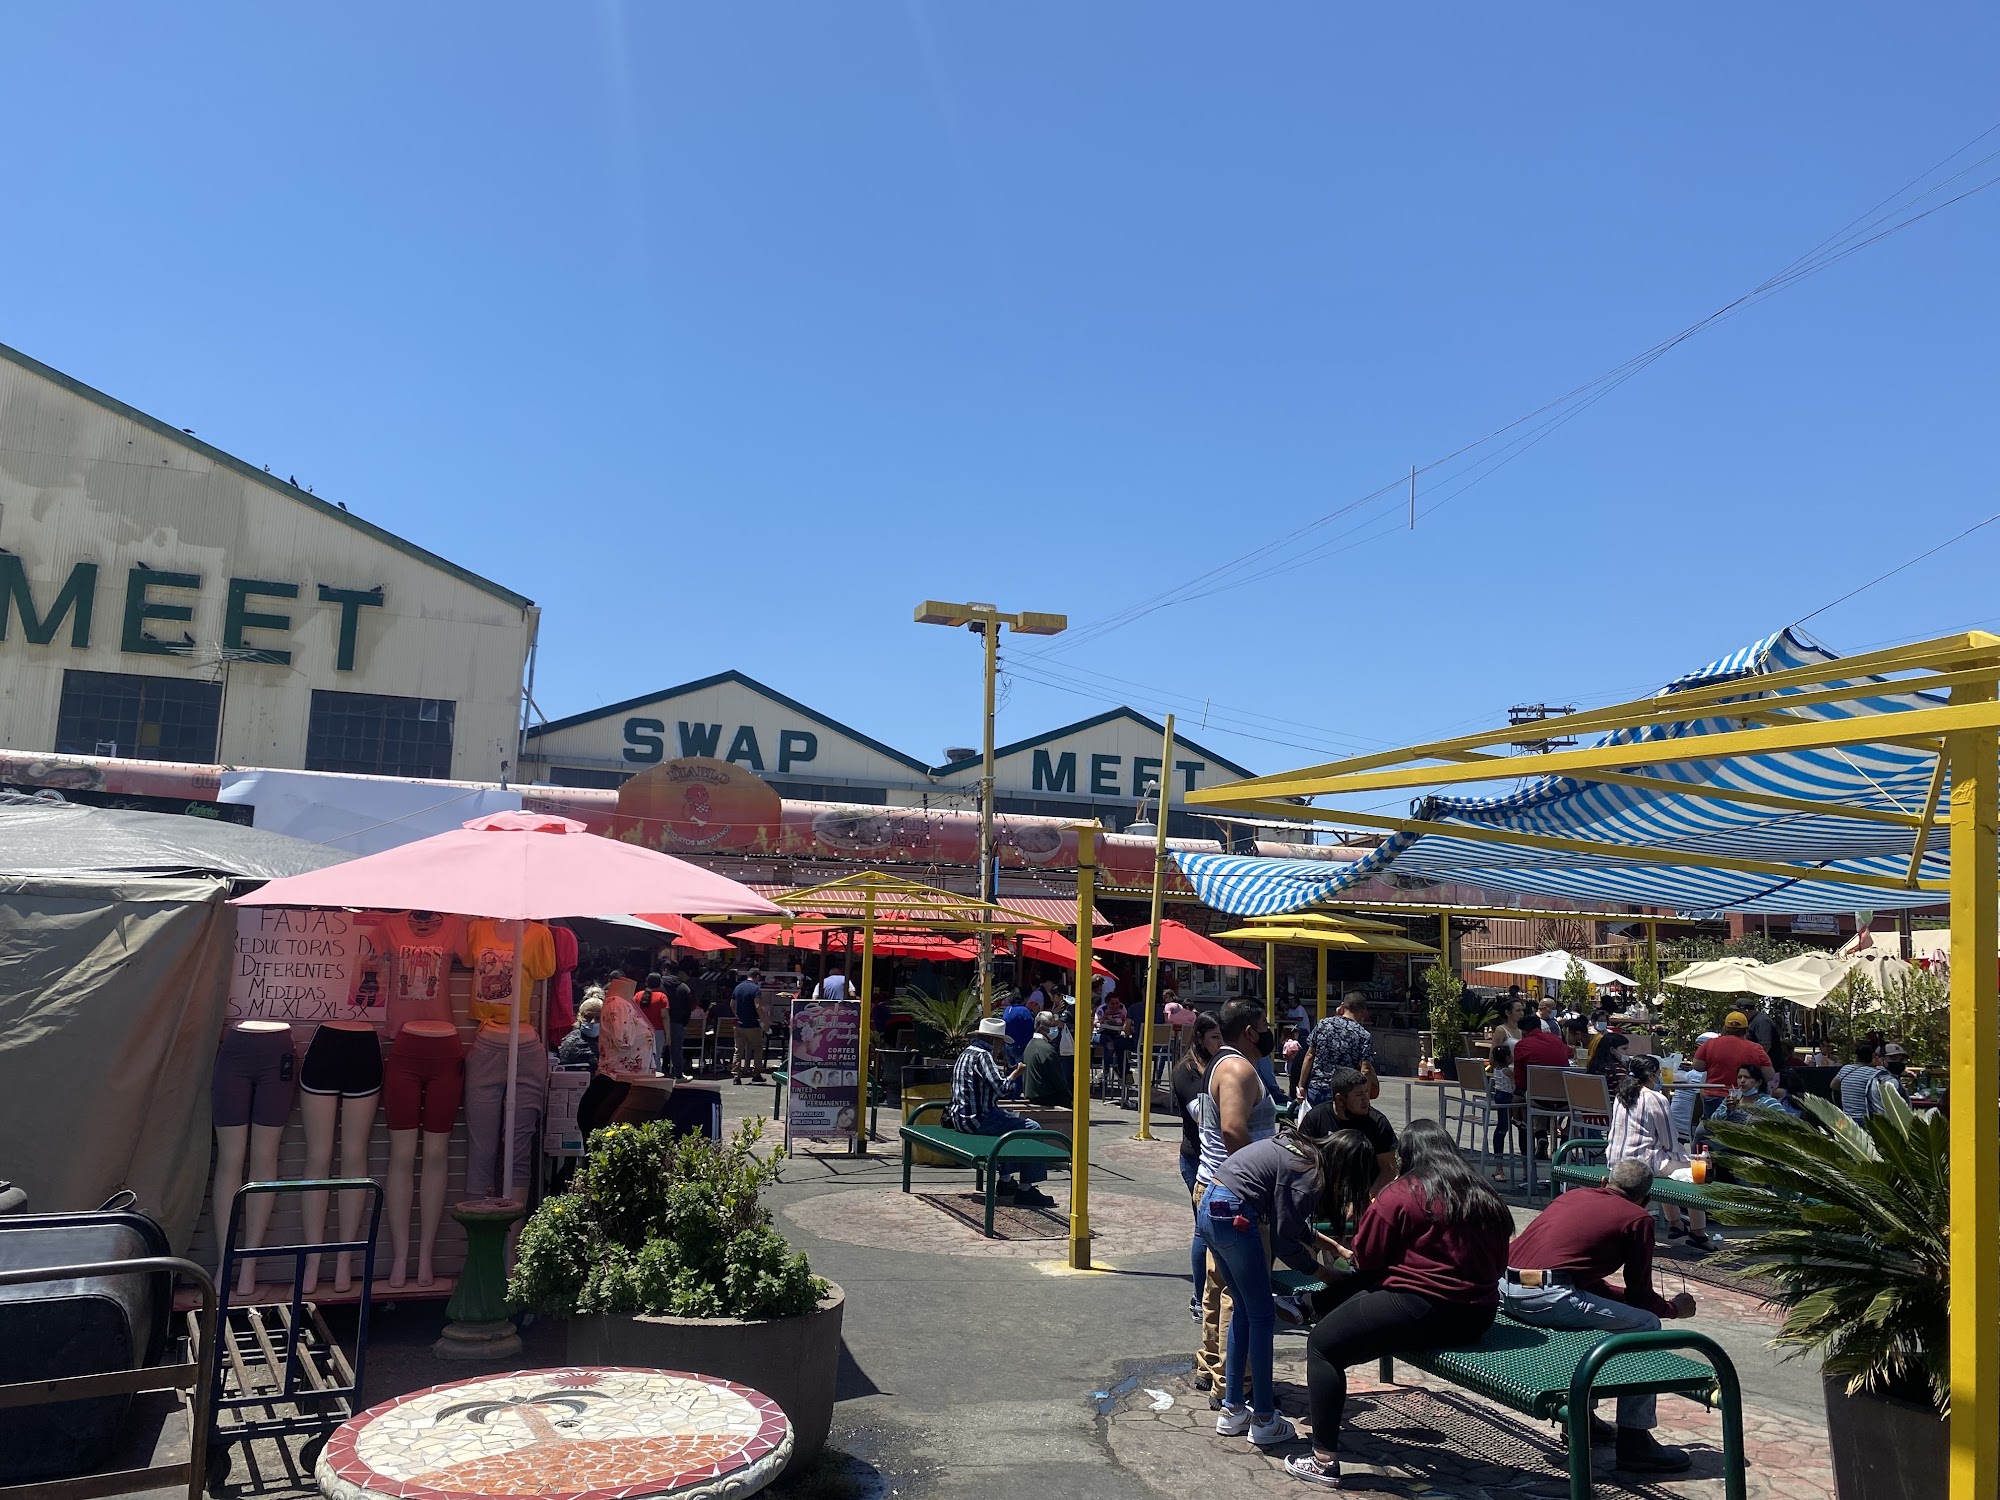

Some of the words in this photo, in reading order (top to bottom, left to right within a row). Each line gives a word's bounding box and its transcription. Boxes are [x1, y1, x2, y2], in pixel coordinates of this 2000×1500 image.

[0, 554, 384, 671] MEET
[622, 718, 818, 773] SWAP
[666, 765, 731, 785] DIABLO
[1032, 749, 1205, 798] MEET
[662, 824, 696, 846] ANTOJITOS
[696, 824, 733, 846] MEXICANOS
[890, 833, 929, 848] ASADA
[260, 908, 347, 934] FAJAS
[400, 946, 442, 959] BOSS
[239, 954, 344, 980] DIFERENTES
[248, 977, 326, 1000] MEDIDAS
[827, 1053, 837, 1061] DE
